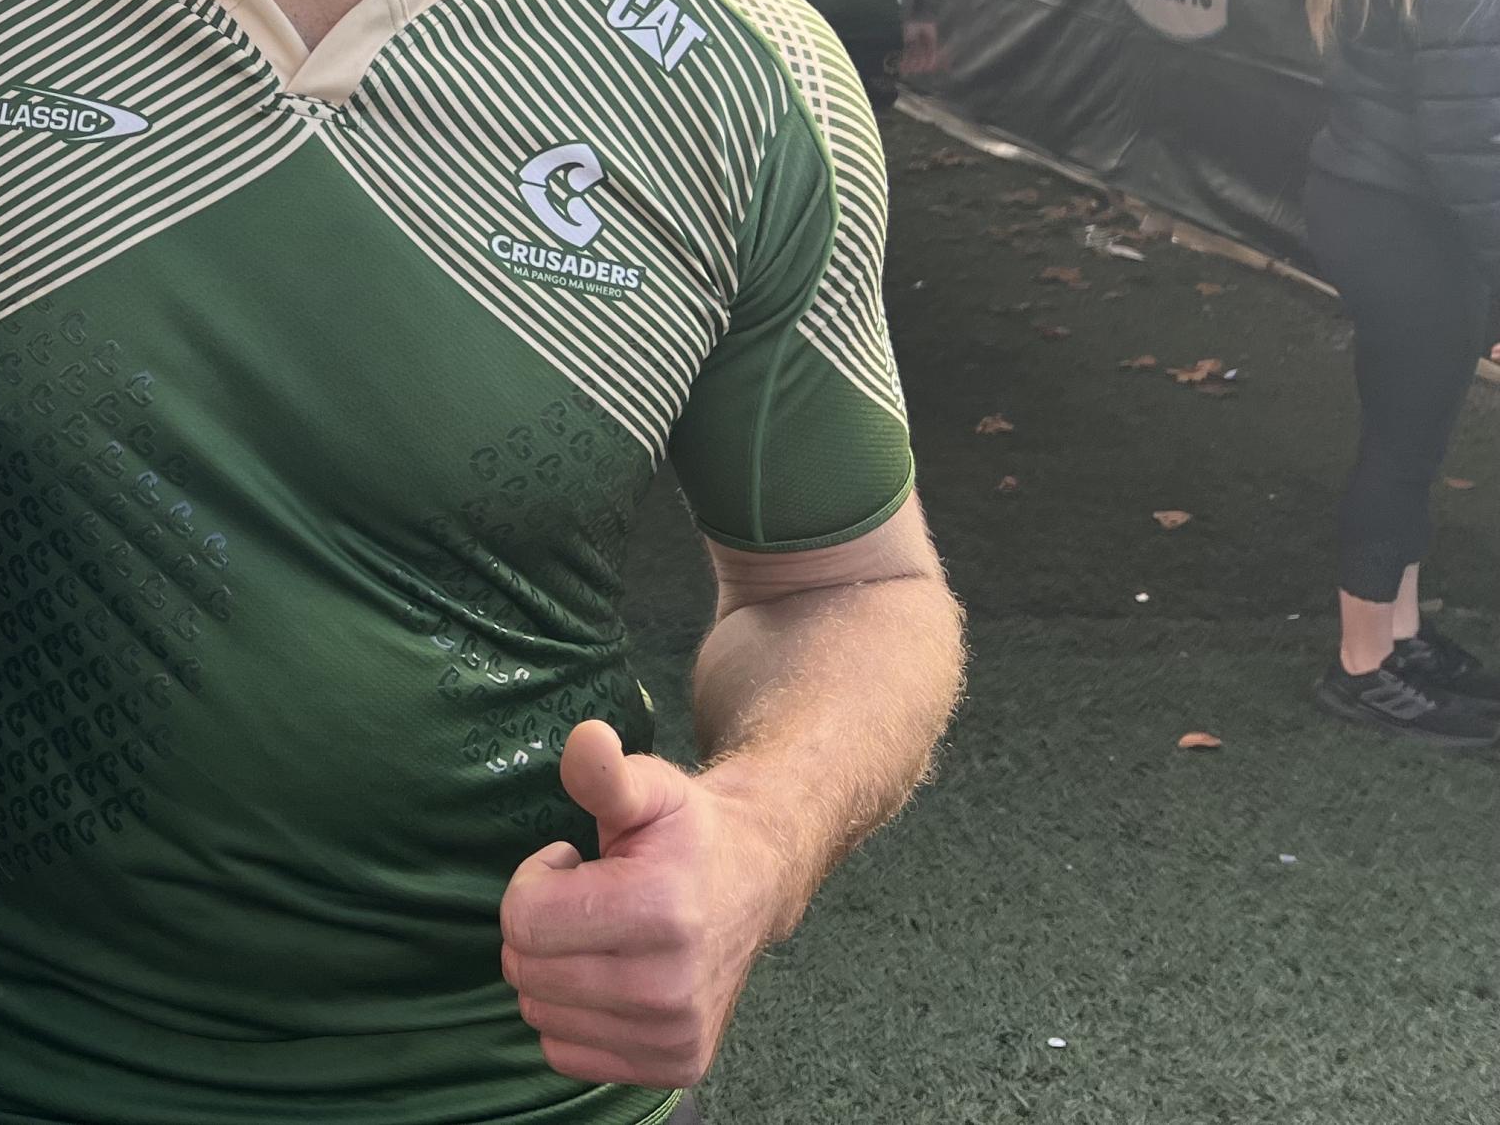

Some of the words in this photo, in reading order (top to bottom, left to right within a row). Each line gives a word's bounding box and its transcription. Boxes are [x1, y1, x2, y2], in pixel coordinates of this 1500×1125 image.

[491, 234, 640, 288] CRUSADERS
[531, 271, 567, 286] PANGO
[586, 283, 622, 298] WHERO
